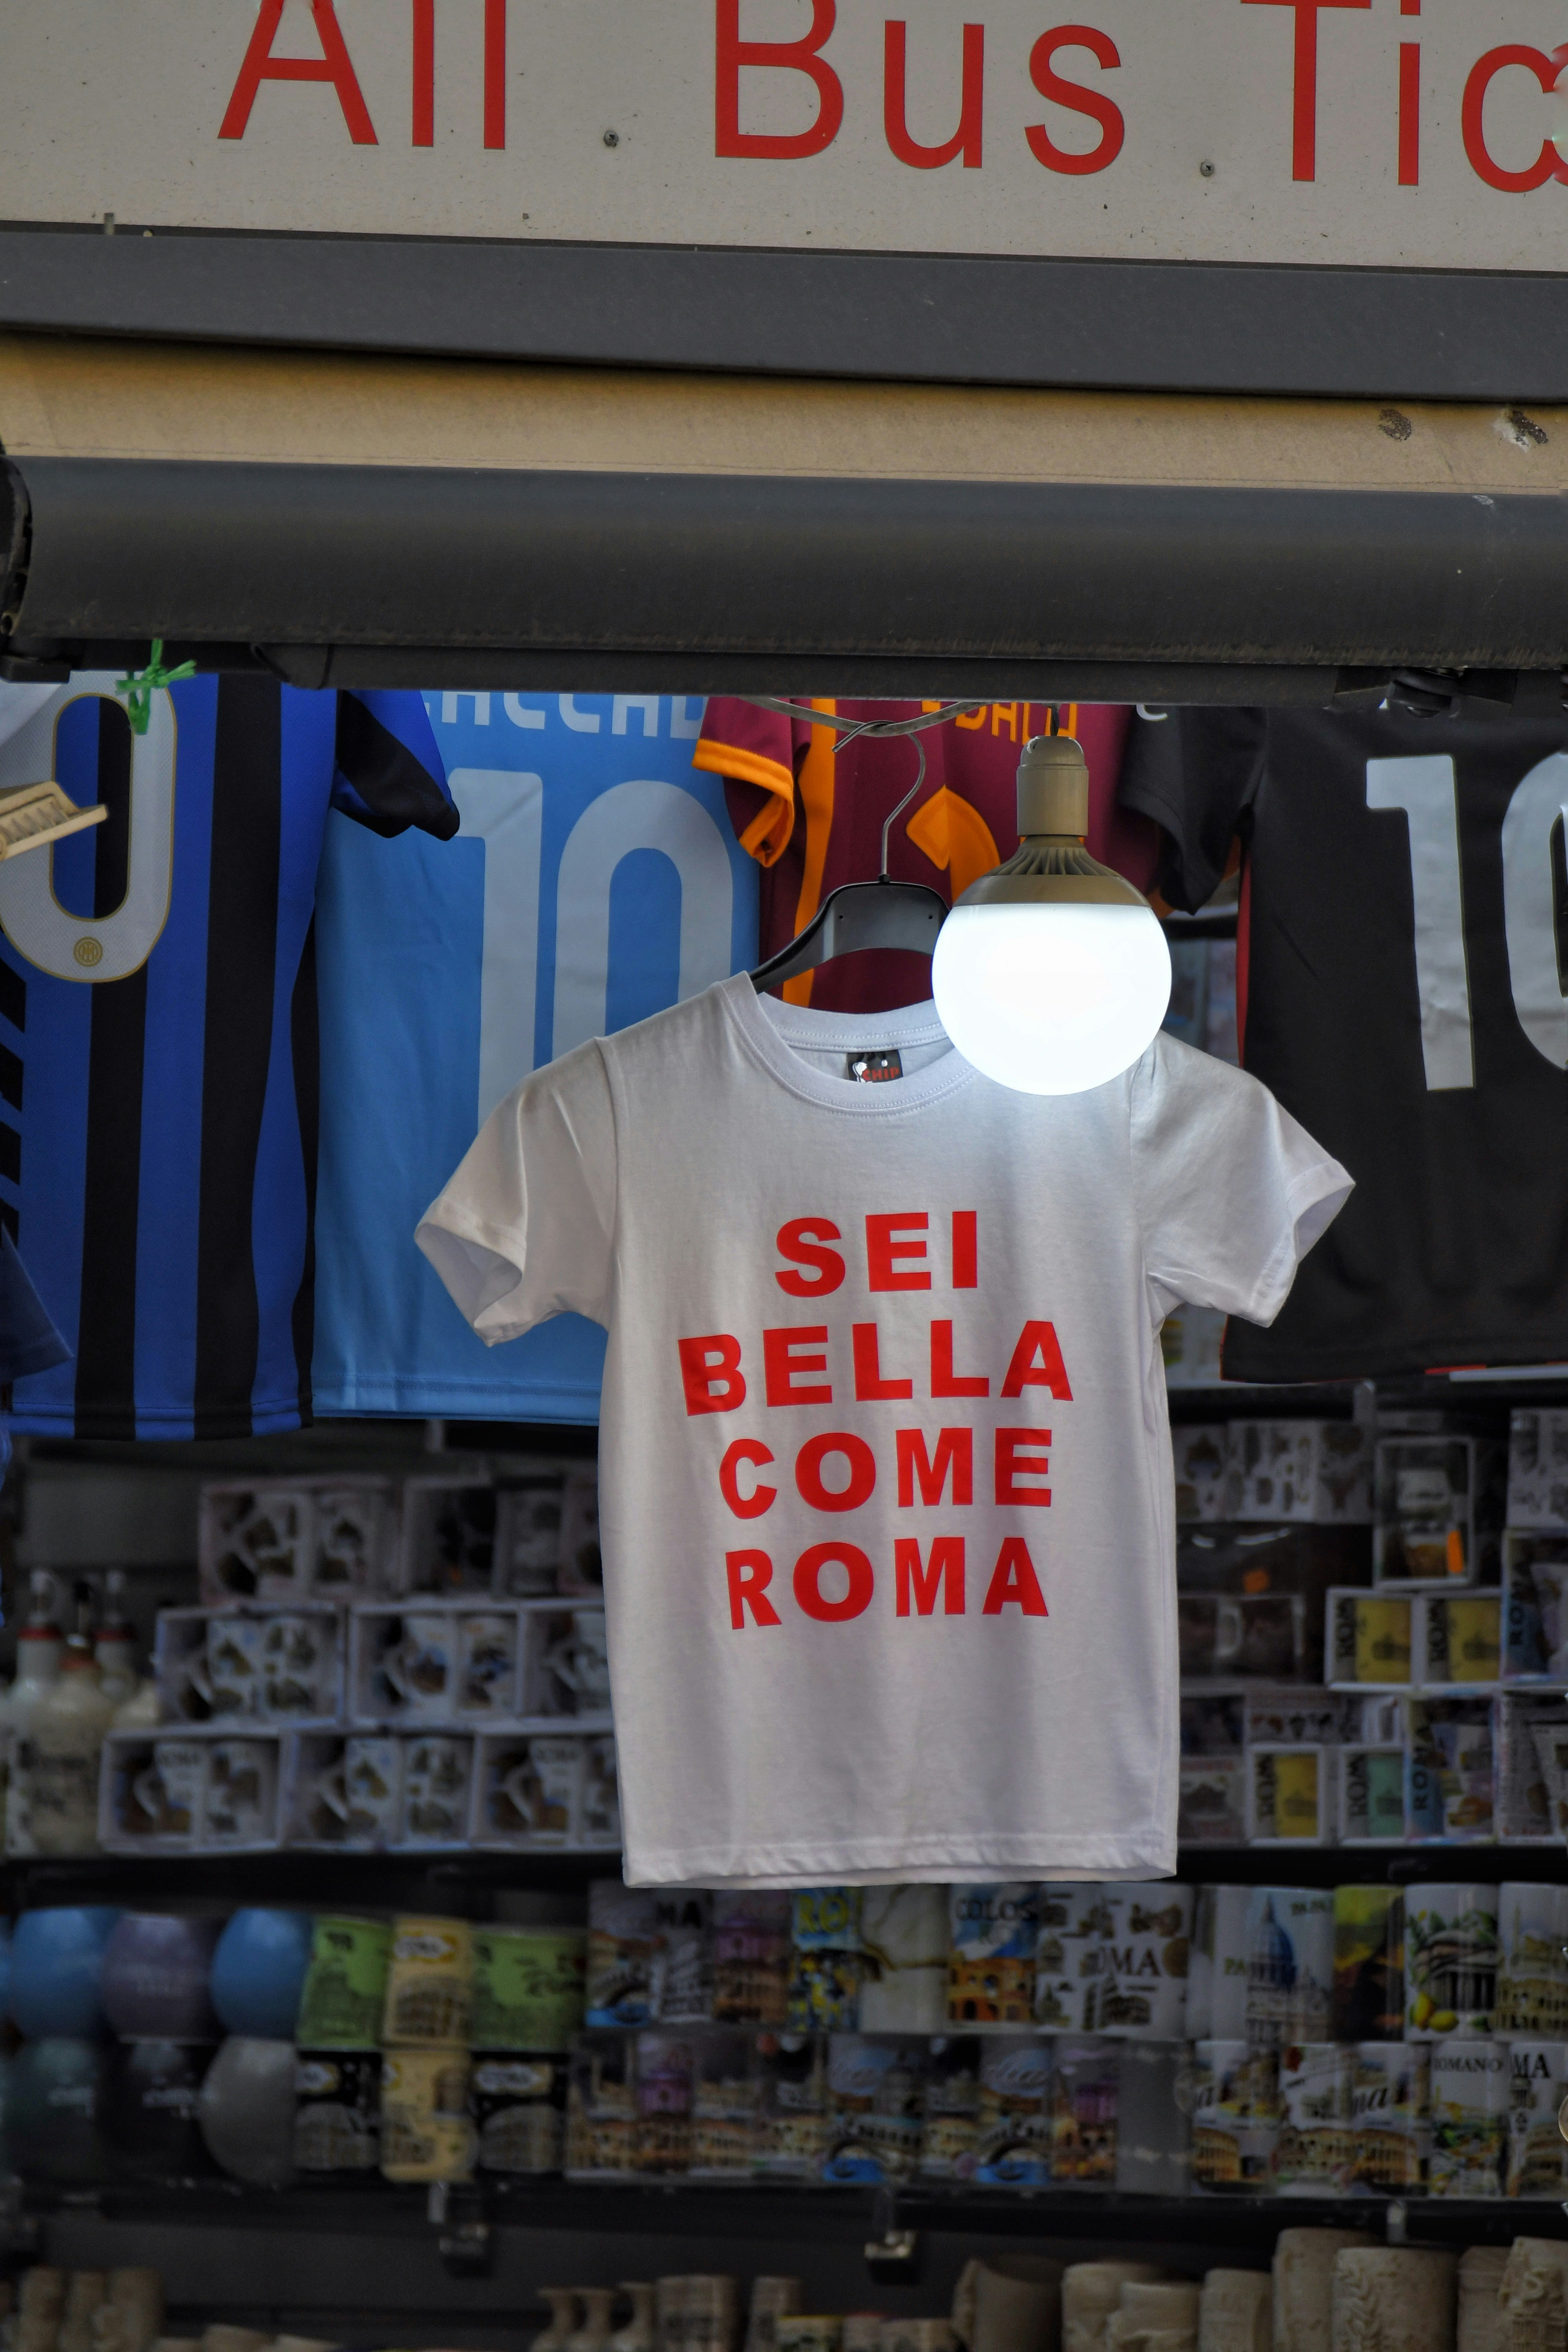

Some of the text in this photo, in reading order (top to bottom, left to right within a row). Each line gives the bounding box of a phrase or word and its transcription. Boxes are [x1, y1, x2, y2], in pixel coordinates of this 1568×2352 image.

[715, 0, 1124, 175] Bus
[446, 768, 733, 1136] 10
[862, 1067, 900, 1081] CHIP
[774, 1210, 977, 1298] SEI
[678, 1319, 1073, 1417] BELLA
[719, 1427, 1052, 1520] COME
[725, 1536, 1049, 1630] ROMA
